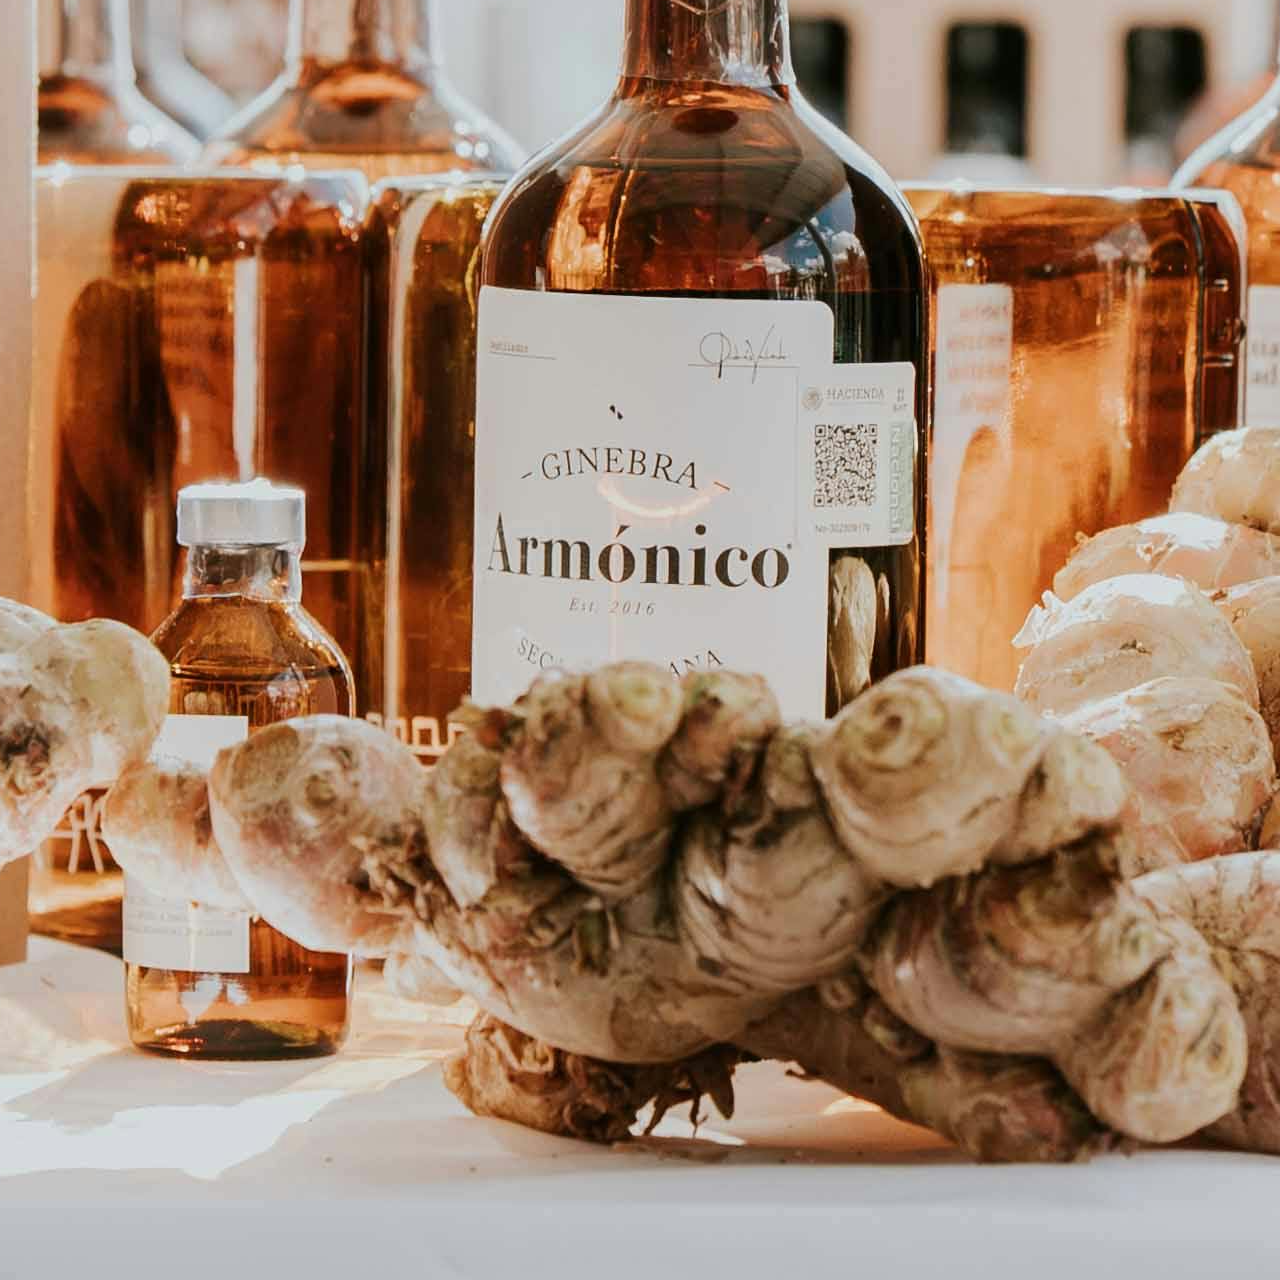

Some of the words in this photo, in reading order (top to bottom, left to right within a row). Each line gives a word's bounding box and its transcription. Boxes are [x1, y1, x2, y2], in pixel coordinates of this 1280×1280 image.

[540, 446, 698, 490] GINEBRA
[486, 512, 790, 589] Armónico
[609, 599, 657, 616] 2016
